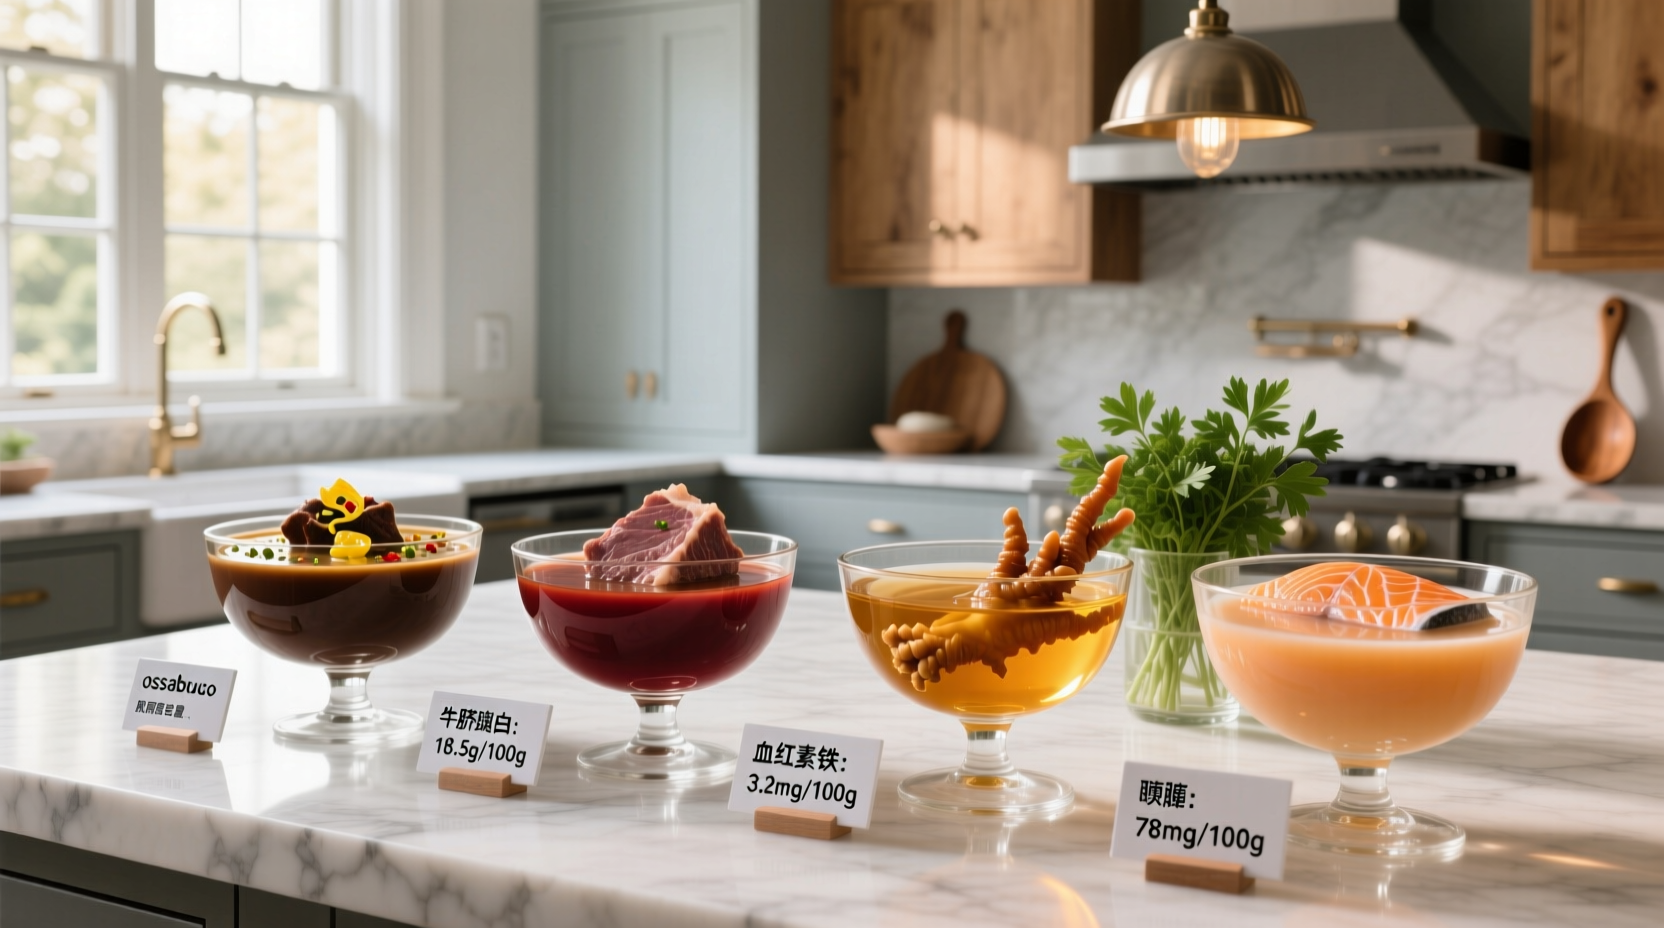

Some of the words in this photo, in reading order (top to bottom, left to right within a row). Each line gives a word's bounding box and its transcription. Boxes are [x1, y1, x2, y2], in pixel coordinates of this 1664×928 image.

[435, 737, 527, 768] 18.5g/100g
[752, 741, 847, 772] 血红素铁:
[746, 773, 857, 809] 3.2mg/100g
[1135, 816, 1265, 857] 78mg/100g
